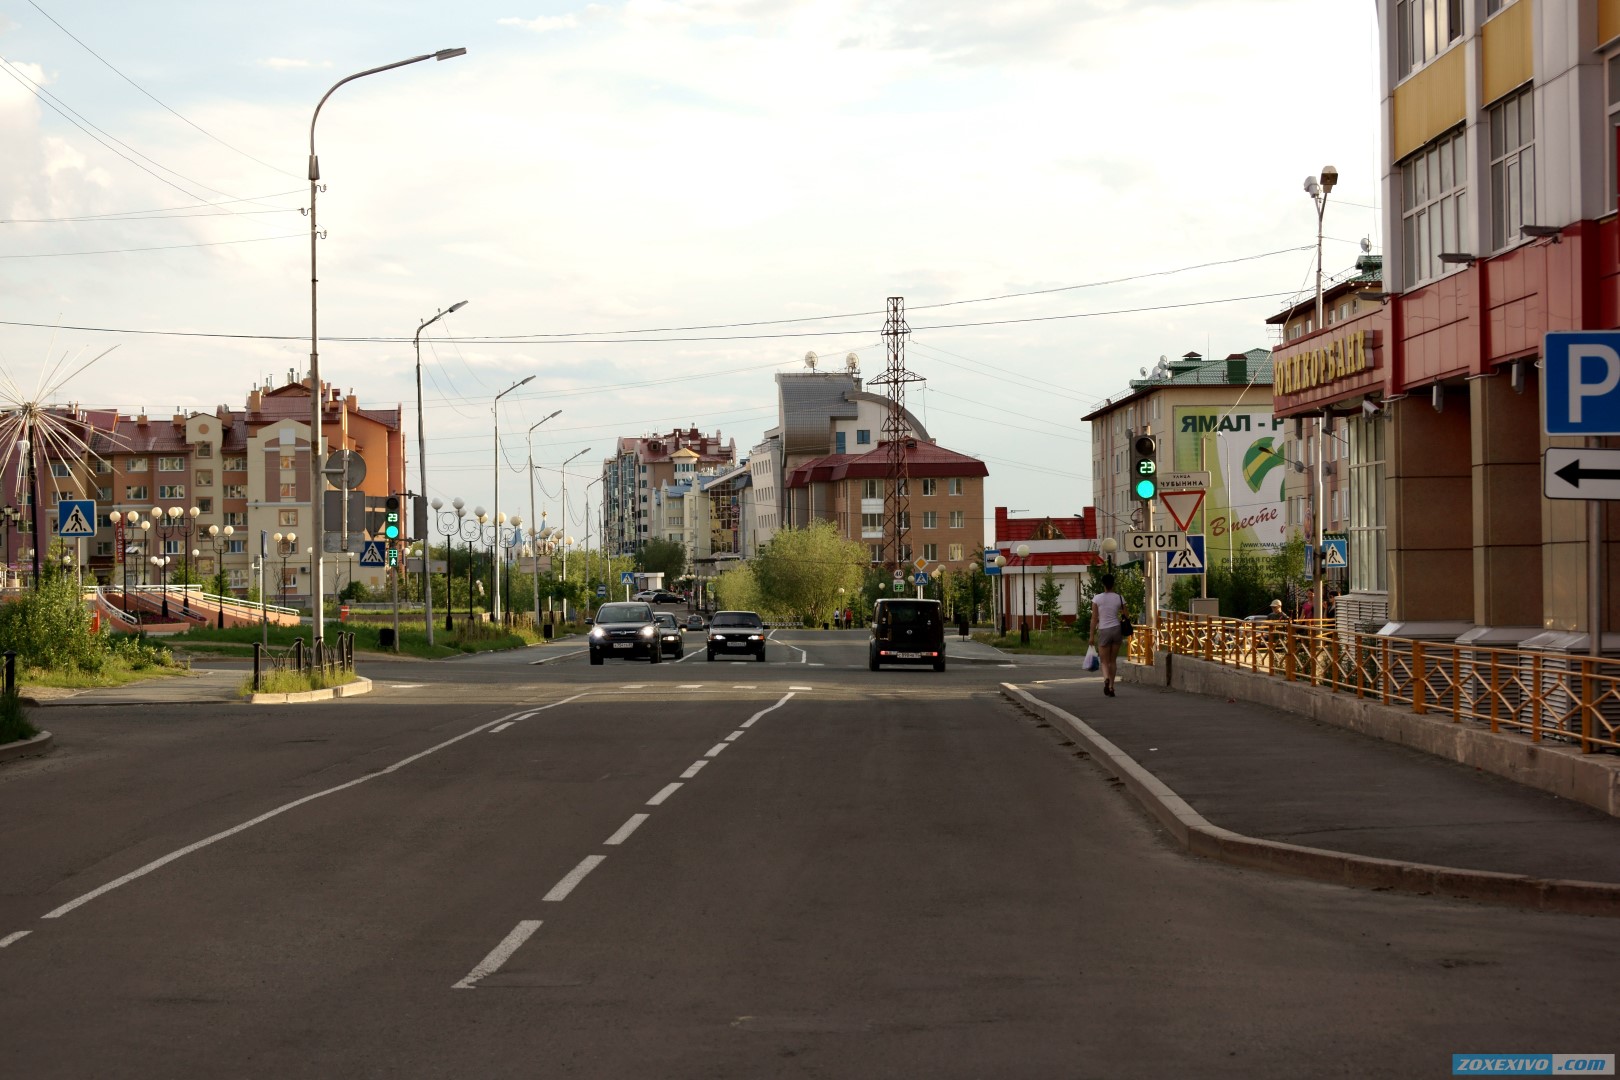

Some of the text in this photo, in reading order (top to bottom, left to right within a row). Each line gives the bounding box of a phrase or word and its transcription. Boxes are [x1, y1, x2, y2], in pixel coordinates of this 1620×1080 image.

[1275, 329, 1366, 397] ЮНИКОРБАНК
[1568, 344, 1620, 423] P
[1181, 415, 1251, 432] ЯМАЛ
[1140, 461, 1155, 474] 23
[1210, 508, 1278, 536] Вместе
[1133, 535, 1178, 548] СТОП
